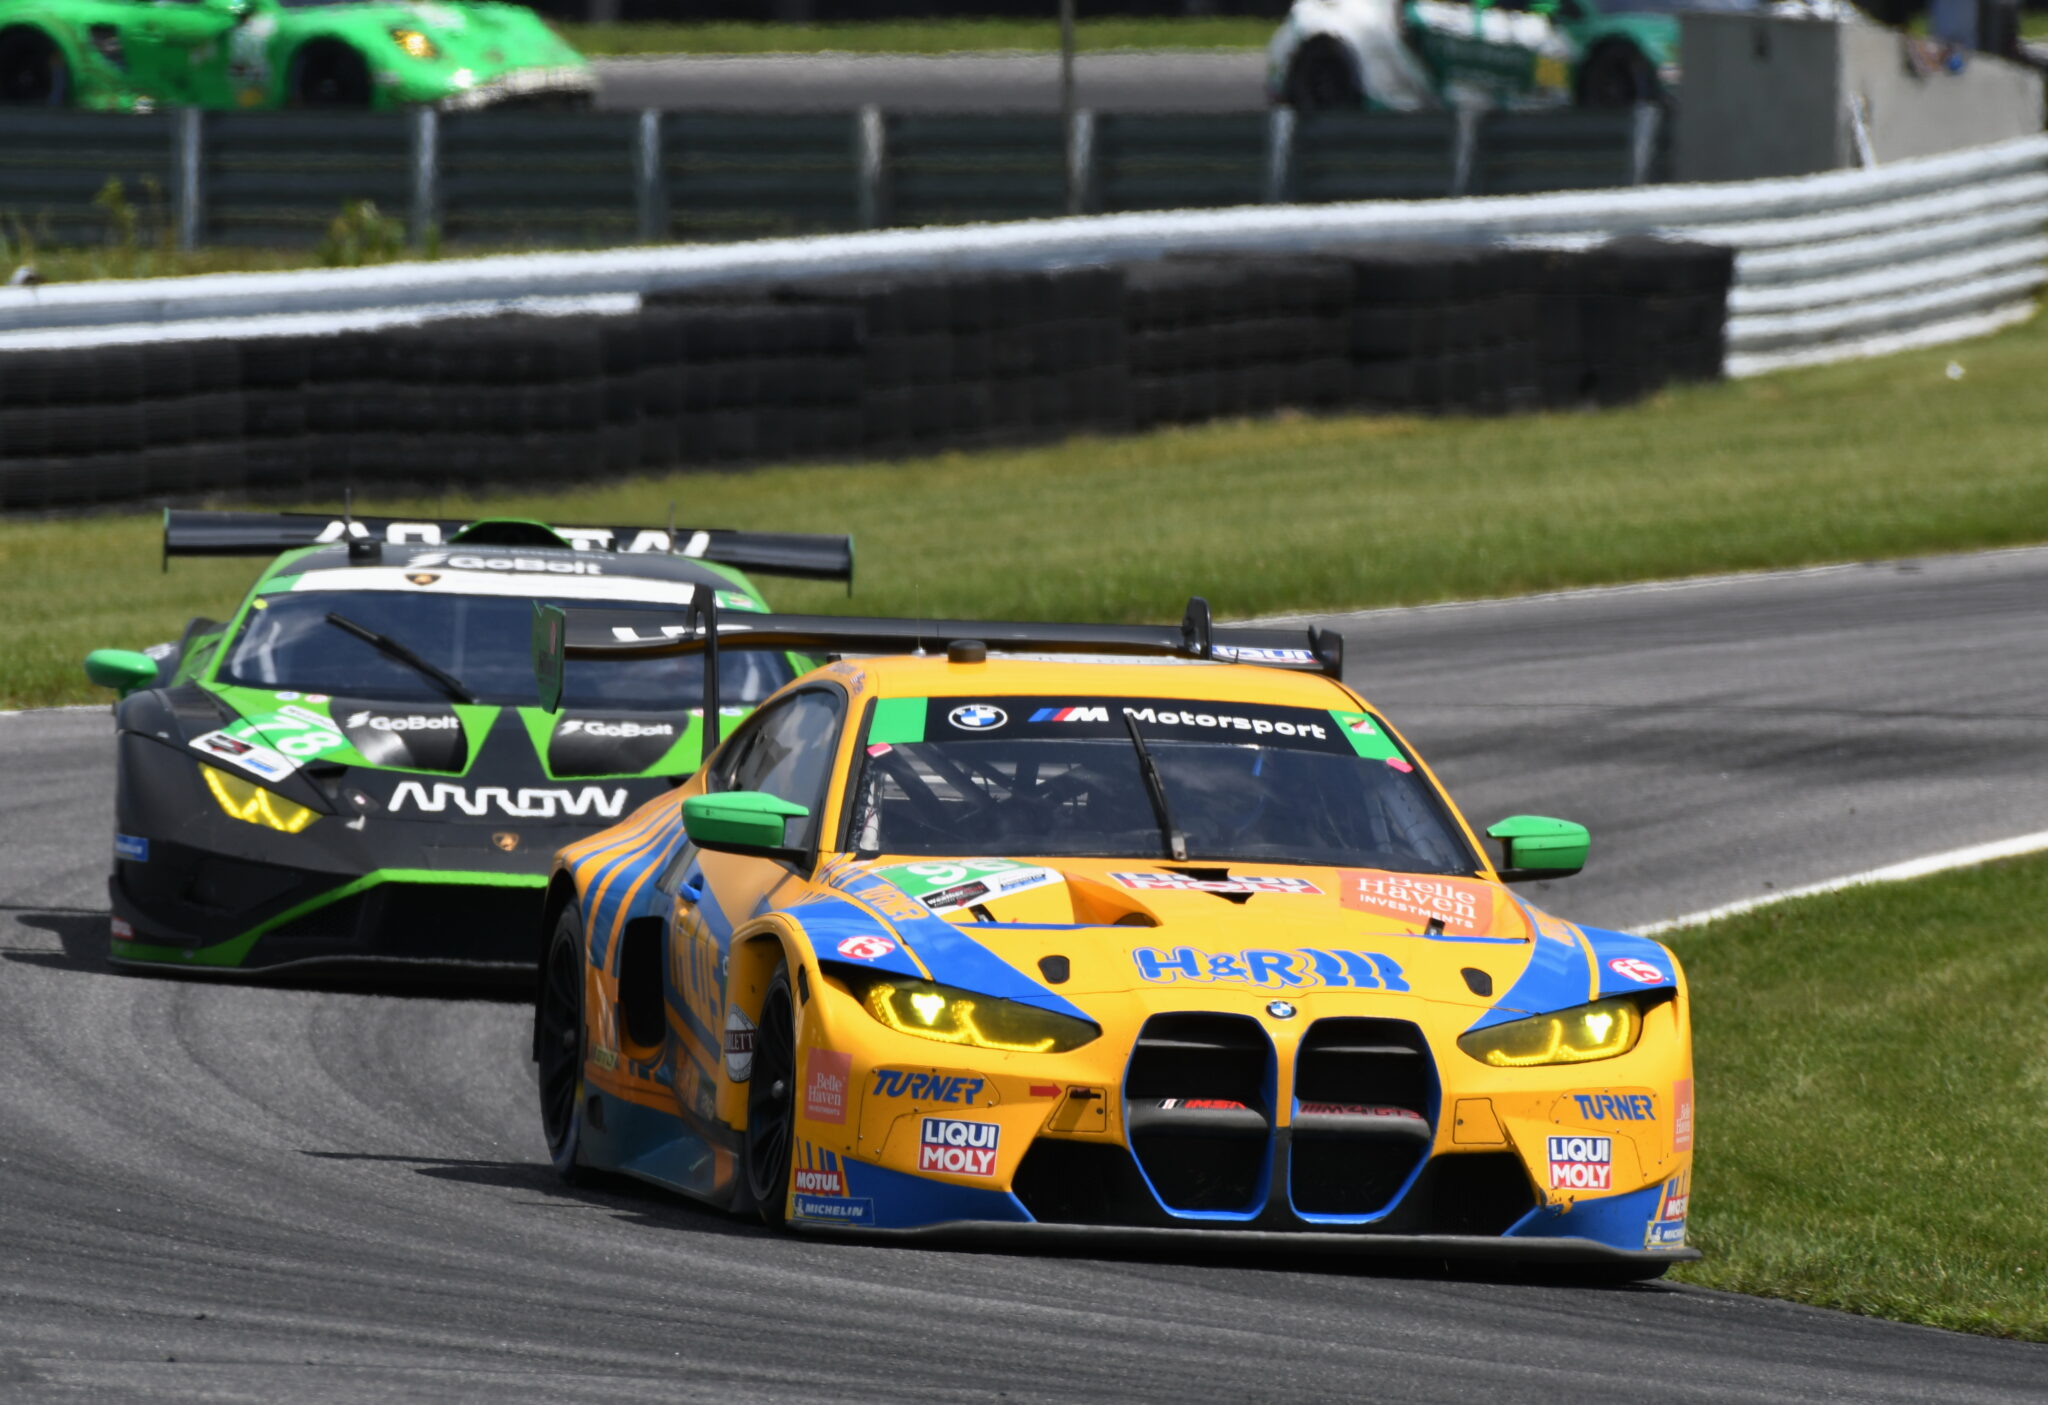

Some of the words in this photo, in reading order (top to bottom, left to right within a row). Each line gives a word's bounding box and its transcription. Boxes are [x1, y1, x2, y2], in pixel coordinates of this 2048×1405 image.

[448, 556, 602, 575] GoBolt
[236, 715, 342, 756] 78
[369, 714, 459, 731] GoBolt
[584, 721, 674, 737] GoBolt
[1123, 707, 1326, 740] Motorsport
[388, 781, 627, 817] ARROW
[1357, 878, 1477, 919] Haven
[1359, 894, 1474, 929] INVESTMENTS
[1134, 946, 1314, 988] H&R
[808, 1084, 841, 1106] Haven
[817, 1071, 842, 1093] Belle
[872, 1069, 984, 1104] TURNER
[1573, 1094, 1656, 1120] TURNER
[925, 1120, 997, 1148] LIQUI
[922, 1146, 995, 1173] MOLY
[1550, 1138, 1609, 1163] LIQUI
[797, 1171, 841, 1191] MOTUL
[1552, 1164, 1610, 1187] MOLY
[804, 1203, 864, 1217] MICHELIN
